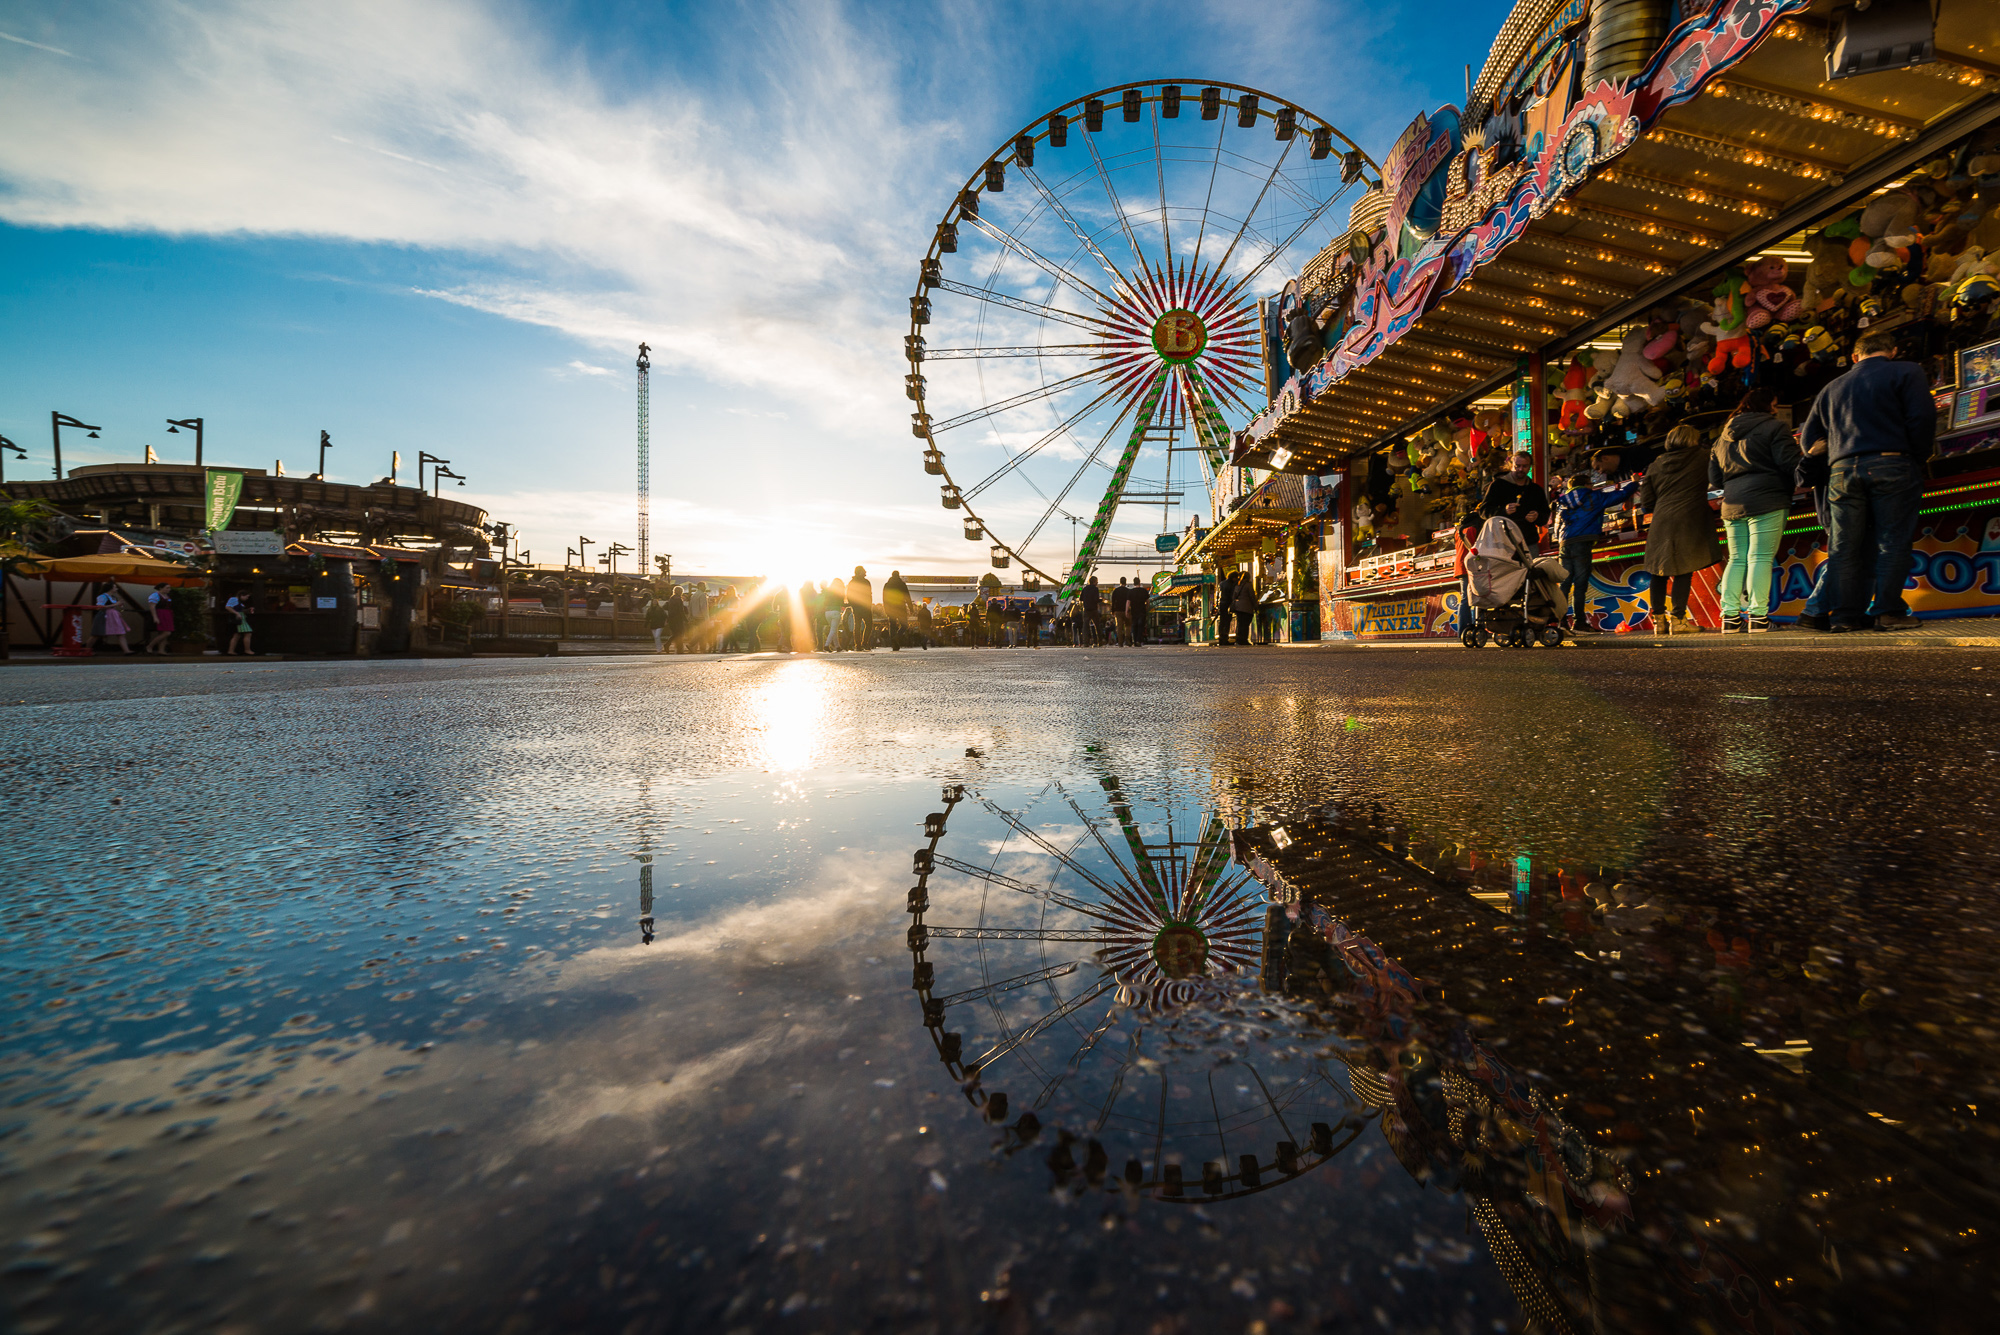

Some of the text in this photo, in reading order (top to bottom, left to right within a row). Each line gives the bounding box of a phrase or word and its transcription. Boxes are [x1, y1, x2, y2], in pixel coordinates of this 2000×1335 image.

[1381, 112, 1428, 193] RIVIERA
[1388, 132, 1449, 242] ADVENTURE
[1162, 315, 1199, 354] B
[212, 475, 227, 496] Bräu
[1768, 550, 2000, 613] JAPOT
[1352, 603, 1423, 633] WINNER
[1372, 601, 1424, 617] TAKES IT ALL
